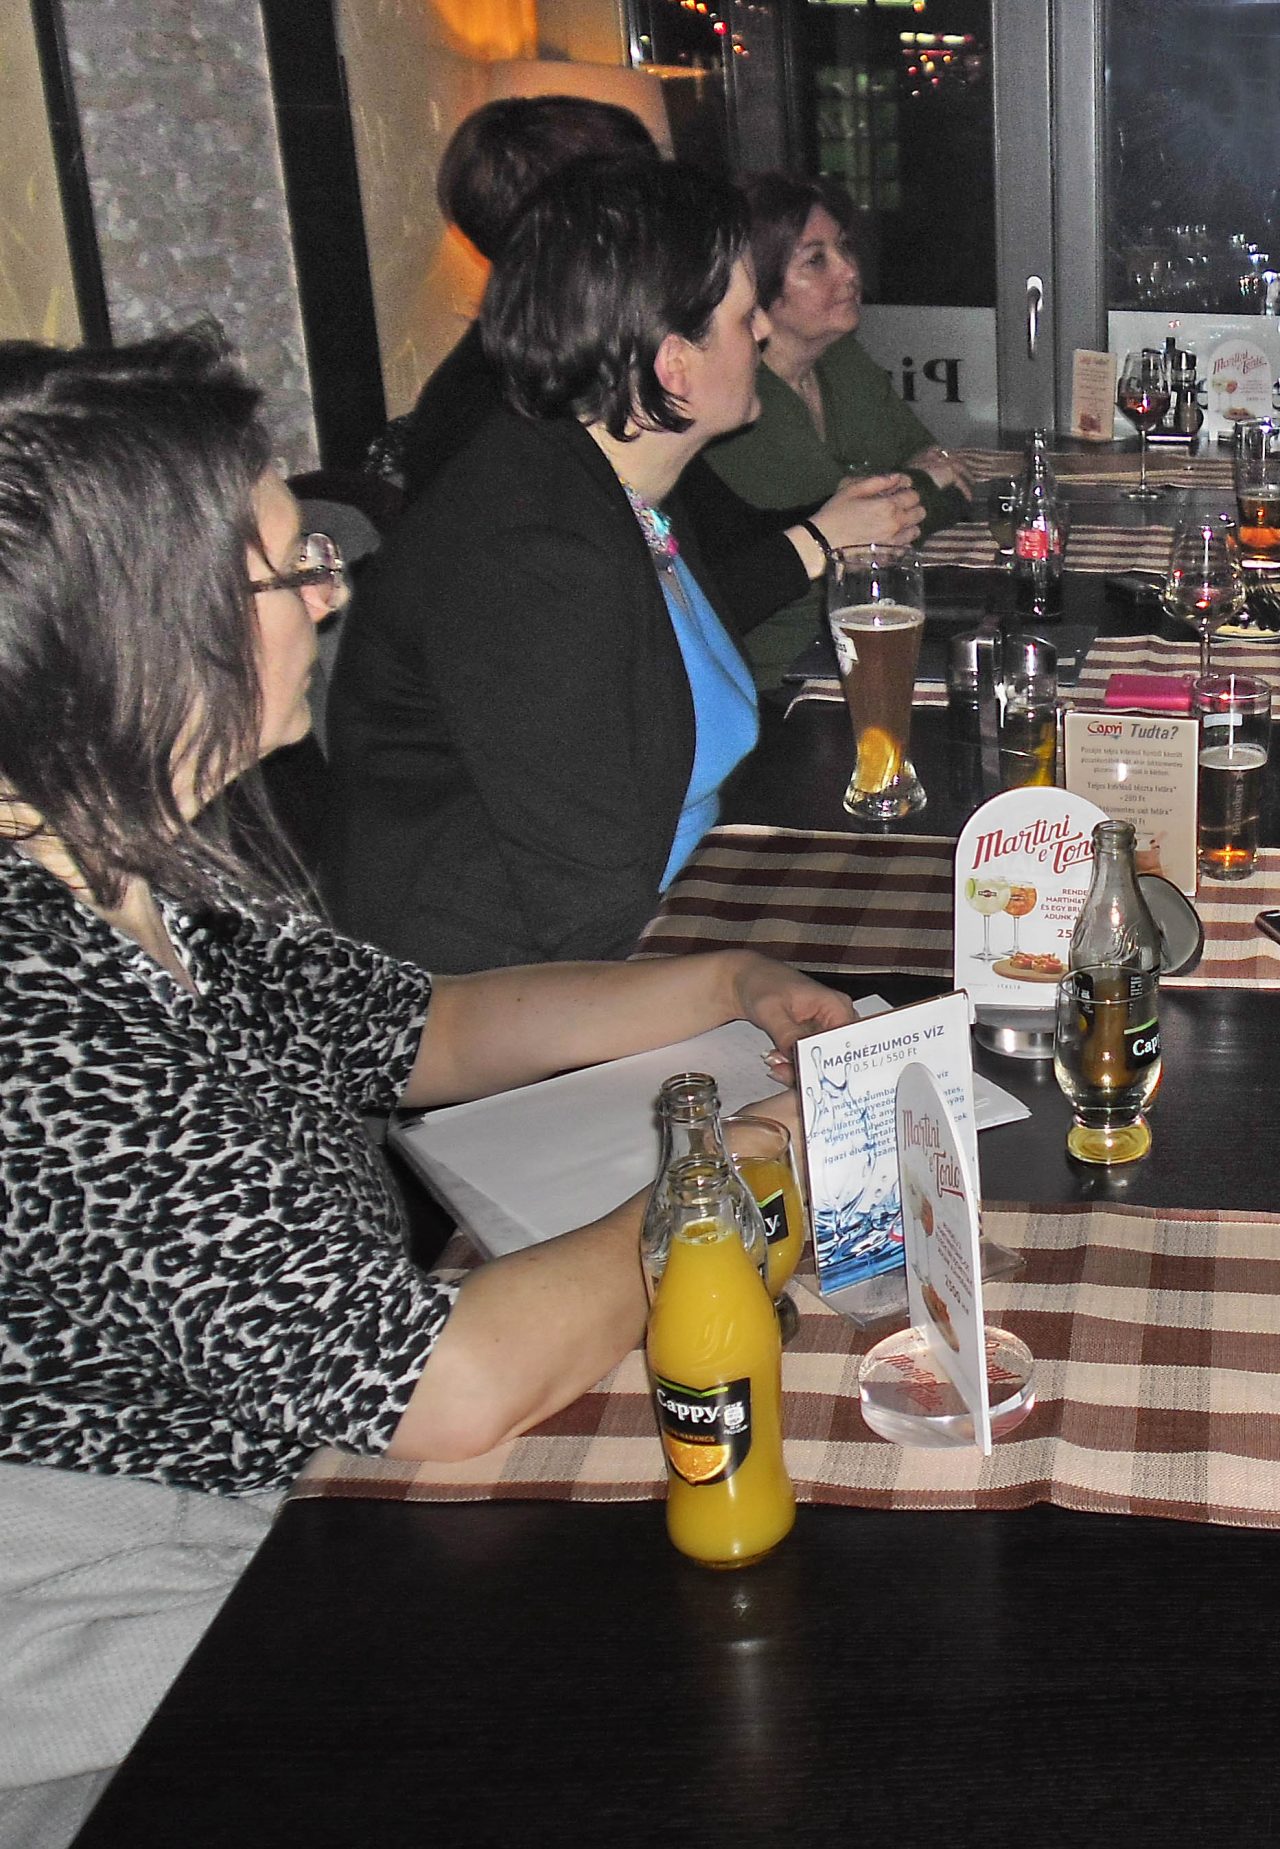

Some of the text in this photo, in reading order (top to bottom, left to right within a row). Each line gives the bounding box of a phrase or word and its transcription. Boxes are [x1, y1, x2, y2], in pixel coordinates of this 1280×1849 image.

[1130, 723, 1179, 740] Tudta?
[971, 814, 1071, 869] Martini
[1050, 832, 1094, 874] Ton
[1045, 896, 1086, 905] MARTINI&T
[1062, 888, 1088, 896] RENDE
[1056, 928, 1073, 939] 25
[823, 1024, 945, 1069] MAGNÉZIUMOS VÍZ
[886, 1050, 905, 1064] 550
[907, 1047, 917, 1057] Ft
[1132, 1033, 1160, 1056] Cap
[902, 1109, 941, 1155] Martini
[932, 1150, 966, 1200] Tonic
[656, 1388, 720, 1424] Cappy
